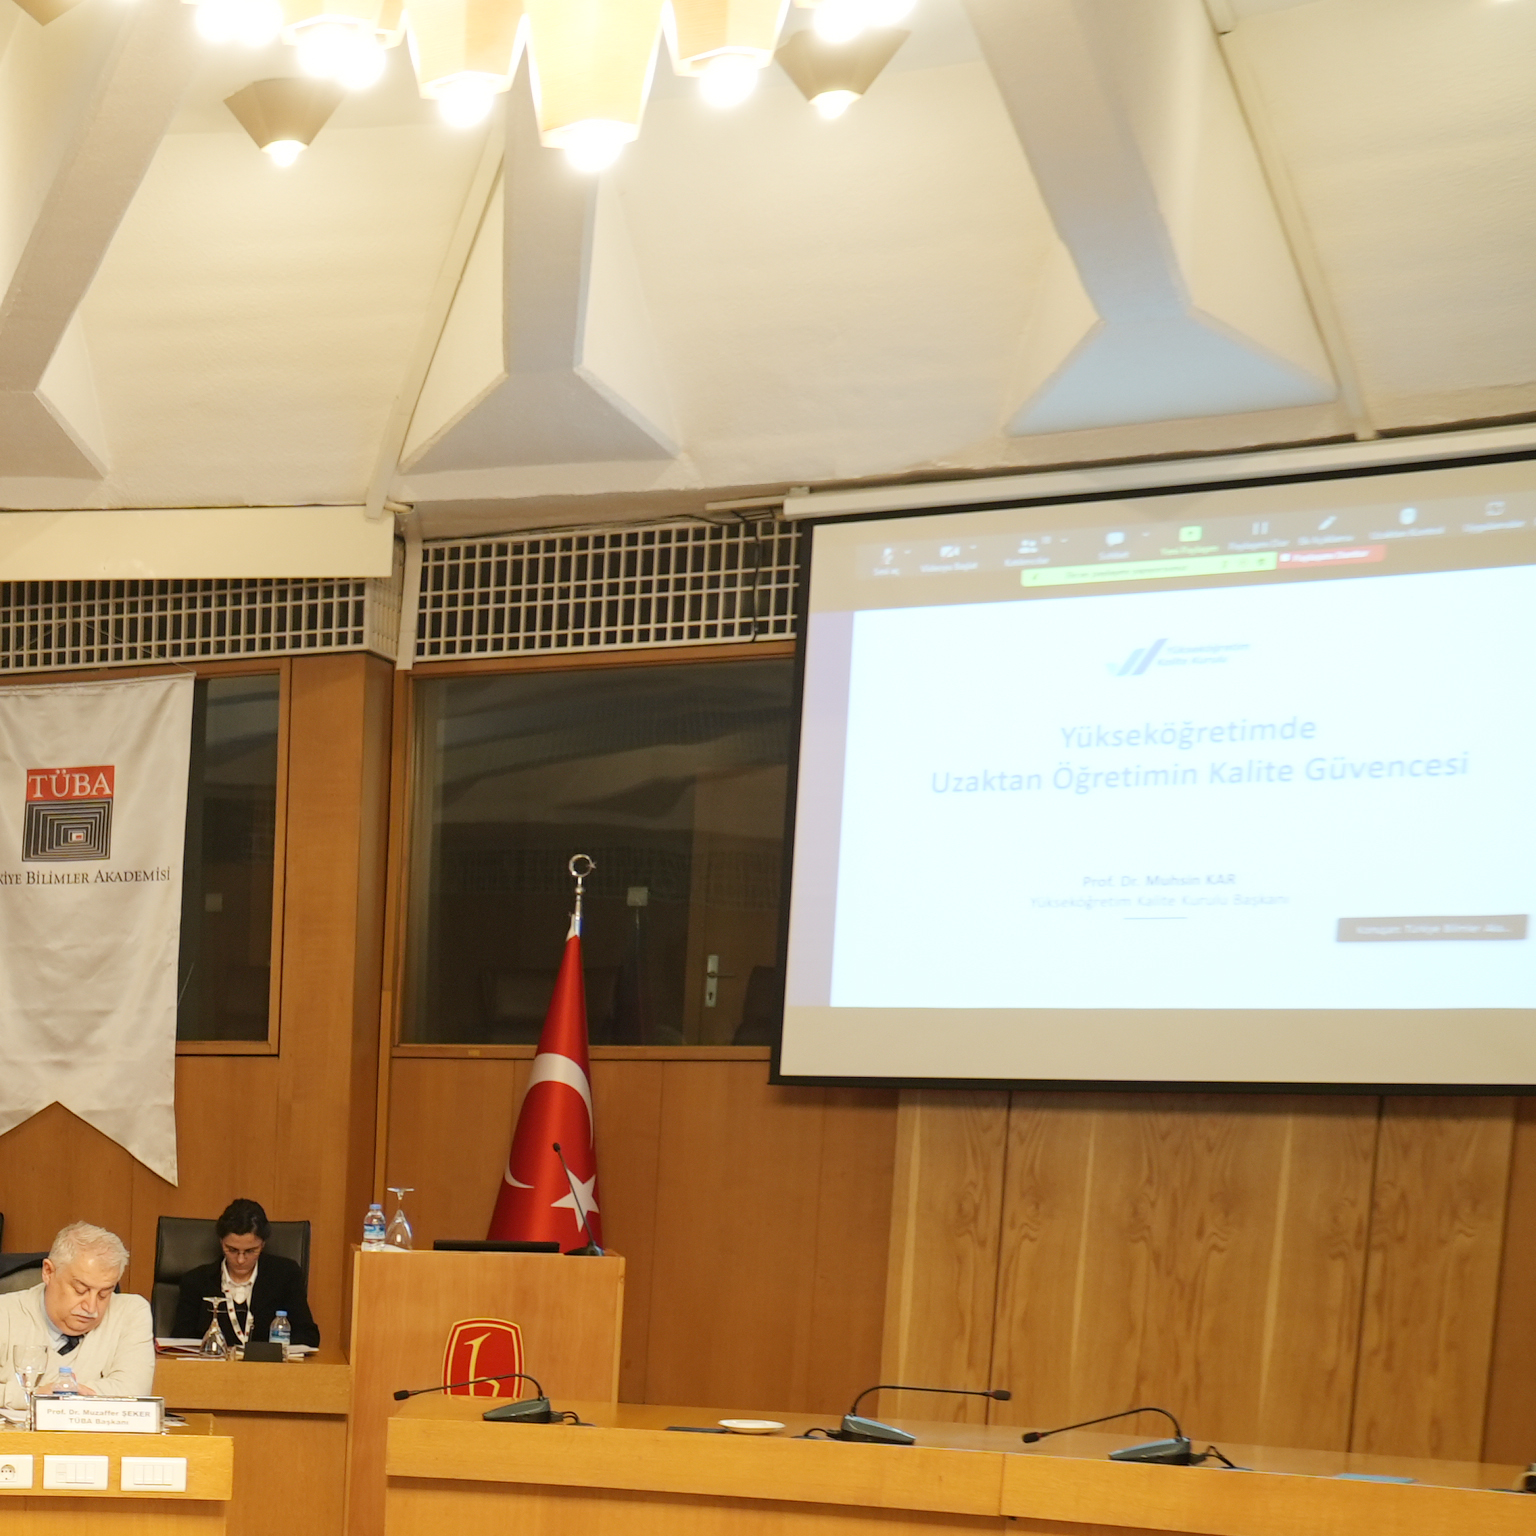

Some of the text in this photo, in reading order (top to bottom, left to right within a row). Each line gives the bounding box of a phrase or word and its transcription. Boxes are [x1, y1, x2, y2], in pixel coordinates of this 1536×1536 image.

[1060, 715, 1318, 750] Yükseköğretimde
[931, 751, 1470, 794] Uzaktan Öğretimin Kalite Güvencesi
[28, 770, 112, 798] TÜBA
[26, 870, 90, 885] BİLİMLER
[94, 866, 171, 884] AKADEMİSİ
[1082, 873, 1236, 889] Prof. Dr. Muhsin KAR
[95, 1418, 129, 1426] Başkanı
[122, 1410, 151, 1418] ŞEKER
